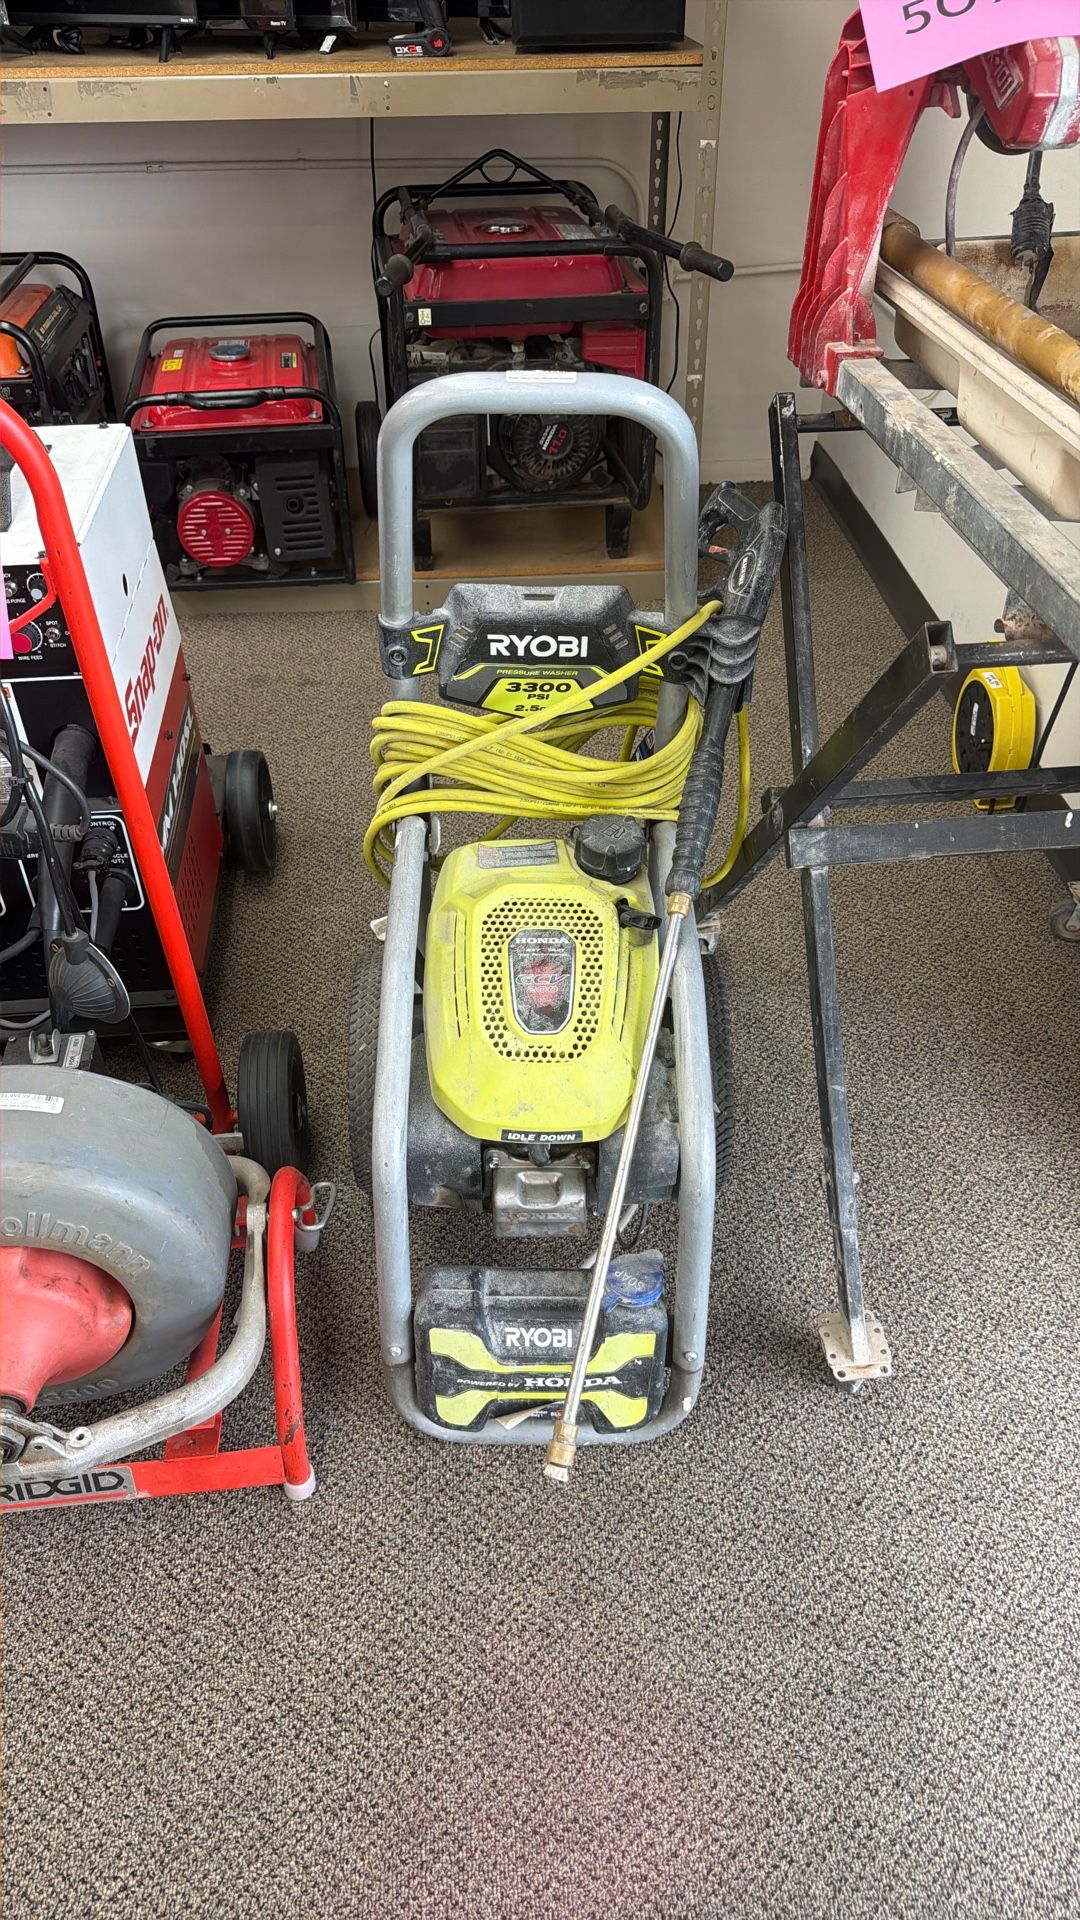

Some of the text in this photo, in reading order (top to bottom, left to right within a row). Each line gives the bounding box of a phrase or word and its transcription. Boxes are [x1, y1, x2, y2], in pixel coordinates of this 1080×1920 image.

[542, 424, 558, 450] HONDA
[487, 634, 588, 658] RYOBI
[505, 682, 572, 693] 3300
[515, 974, 571, 985] GCV
[507, 1133, 535, 1141] IDLE
[0, 1211, 151, 1278] ollmann
[614, 1270, 644, 1290] SOAP
[504, 1327, 573, 1348] RYOBI
[456, 1378, 506, 1387] POWERED
